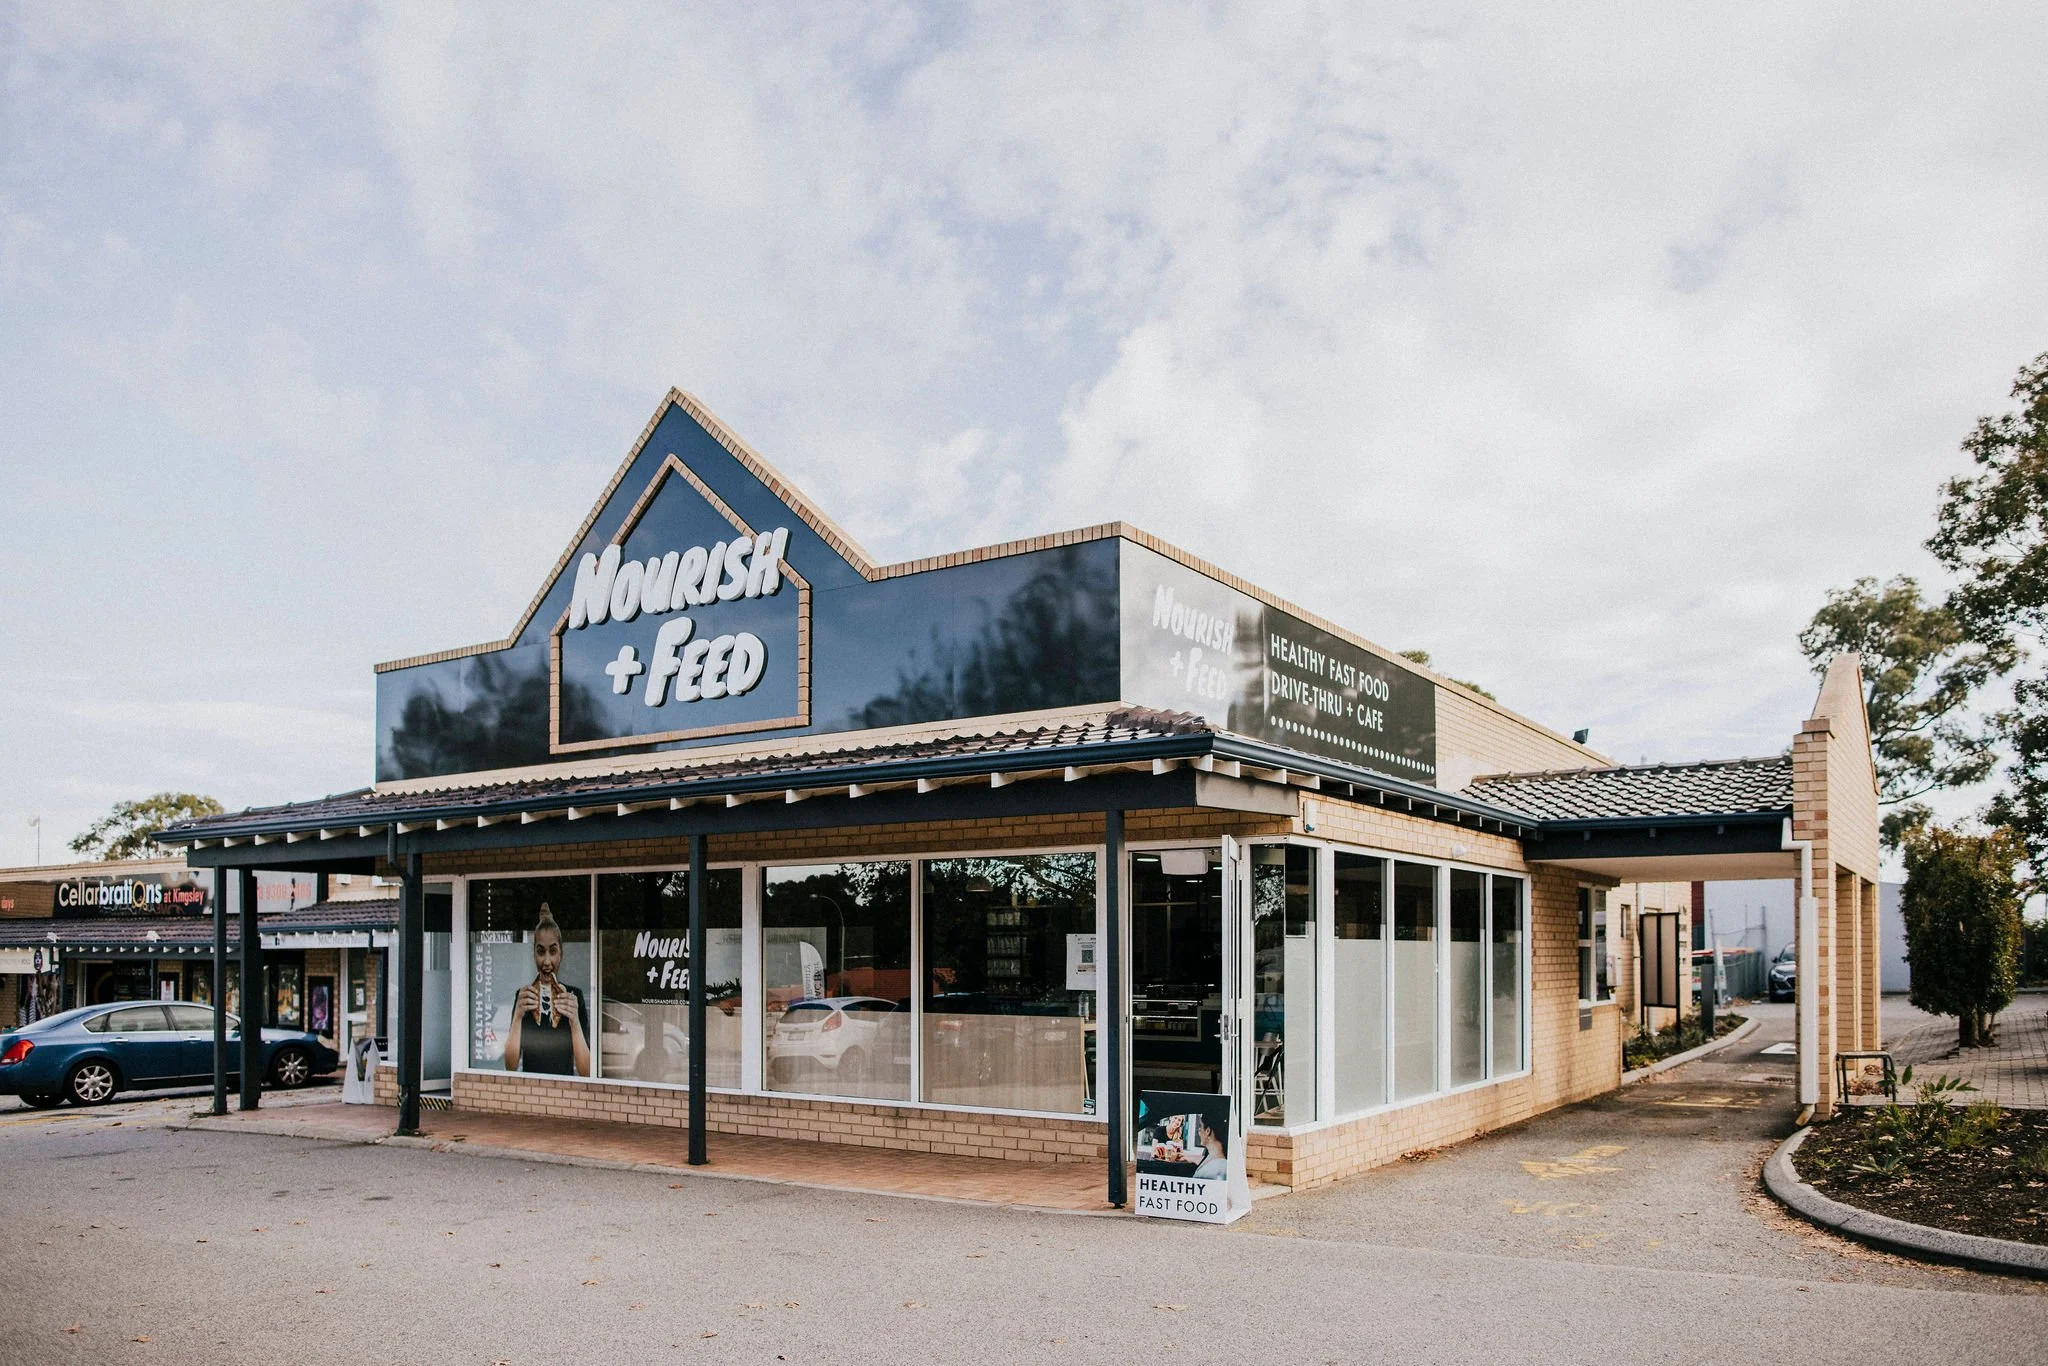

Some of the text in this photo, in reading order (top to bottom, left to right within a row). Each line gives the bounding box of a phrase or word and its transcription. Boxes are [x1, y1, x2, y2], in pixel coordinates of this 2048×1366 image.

[568, 527, 790, 630] NOURISH
[1152, 583, 1235, 656] NOURISH
[644, 616, 767, 708] FEED
[1186, 646, 1228, 700] FEED
[1271, 632, 1390, 702] HEALTHY FAST FOOD
[1271, 670, 1343, 718] DRIVE-THRU
[1357, 703, 1384, 733] CAFE
[163, 892, 172, 904] at
[173, 887, 205, 906] Kingsley
[633, 928, 690, 960] NOURI
[475, 944, 483, 1060] HEALTHY CAFE
[660, 959, 690, 990] FEE
[1139, 1178, 1206, 1196] HEALTHY
[1139, 1195, 1218, 1215] FAST FOOD
